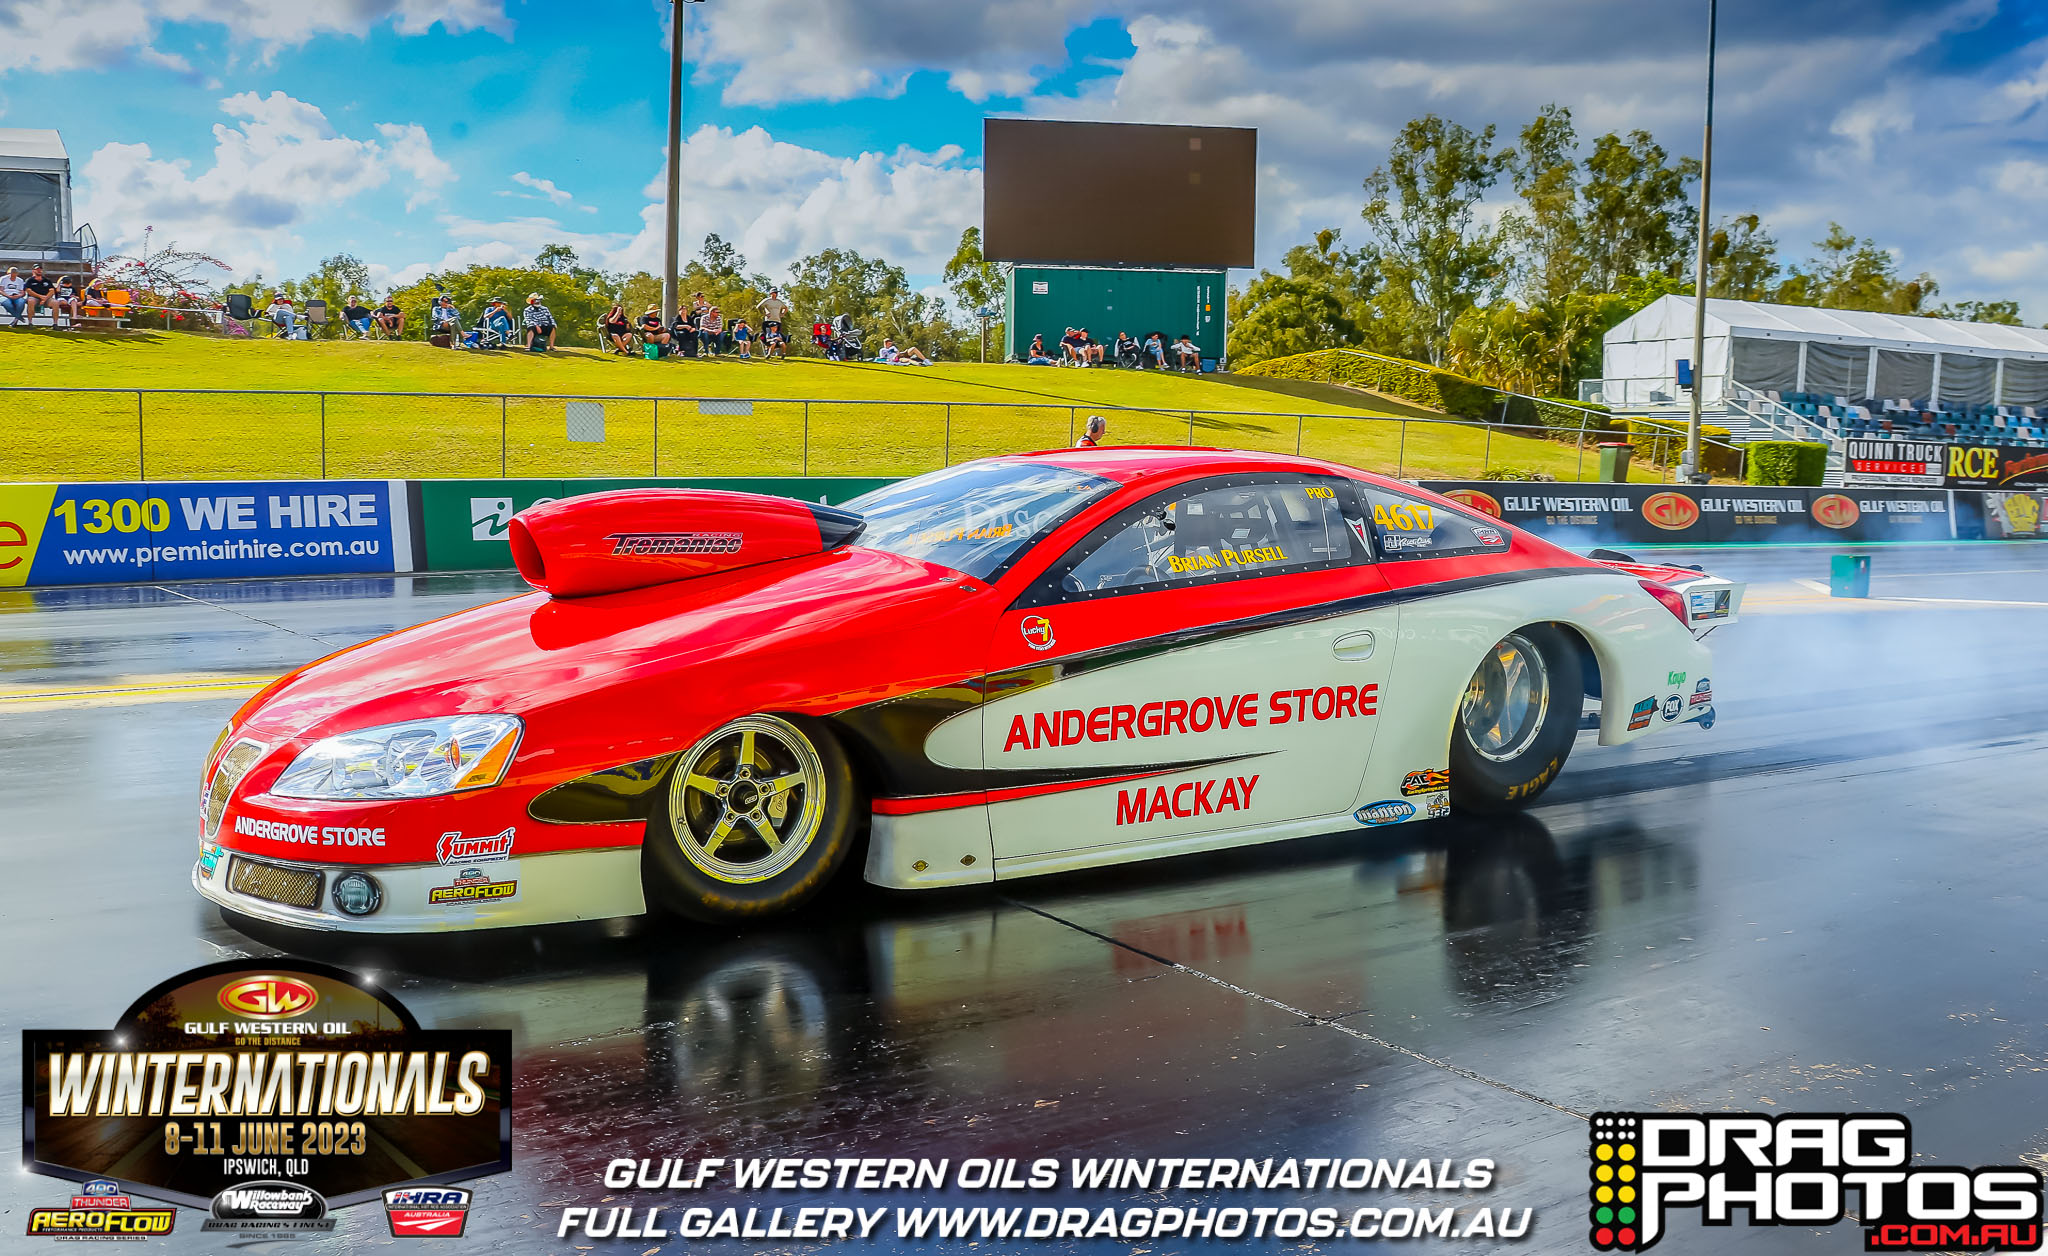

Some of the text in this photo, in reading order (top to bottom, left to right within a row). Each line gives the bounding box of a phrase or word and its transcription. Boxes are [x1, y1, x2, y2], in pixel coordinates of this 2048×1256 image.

[1849, 442, 1943, 462] QUINN TRUCK
[1947, 446, 1999, 478] RCE
[1857, 461, 1924, 473] SERVICES
[1305, 487, 1335, 499] PRO
[1503, 496, 1541, 511] GULF
[1542, 497, 1609, 512] WESTERN
[1611, 497, 1634, 511] OIL
[53, 494, 378, 534] 1300 WE HIRE
[1701, 498, 1806, 512] GULF WESTERN OIL
[1860, 500, 1946, 512] GULF WESTERN OIL
[1374, 504, 1434, 531] 4617
[63, 538, 380, 567] www.premiairhire.com.au
[602, 532, 743, 556] Tremaniac
[1168, 546, 1288, 573] BRIAN PURSELL
[1024, 619, 1050, 641] Lucky 7
[1668, 671, 1686, 689] Kayo
[1003, 683, 1379, 752] ANDERGROVE STORE
[1664, 700, 1680, 713] FOX
[1505, 757, 1559, 800] EAGLE
[1116, 775, 1260, 826] MACKAY
[1357, 803, 1413, 820] manton
[234, 815, 386, 846] ANDERGROVE STORE
[432, 883, 514, 902] AEROFLOW
